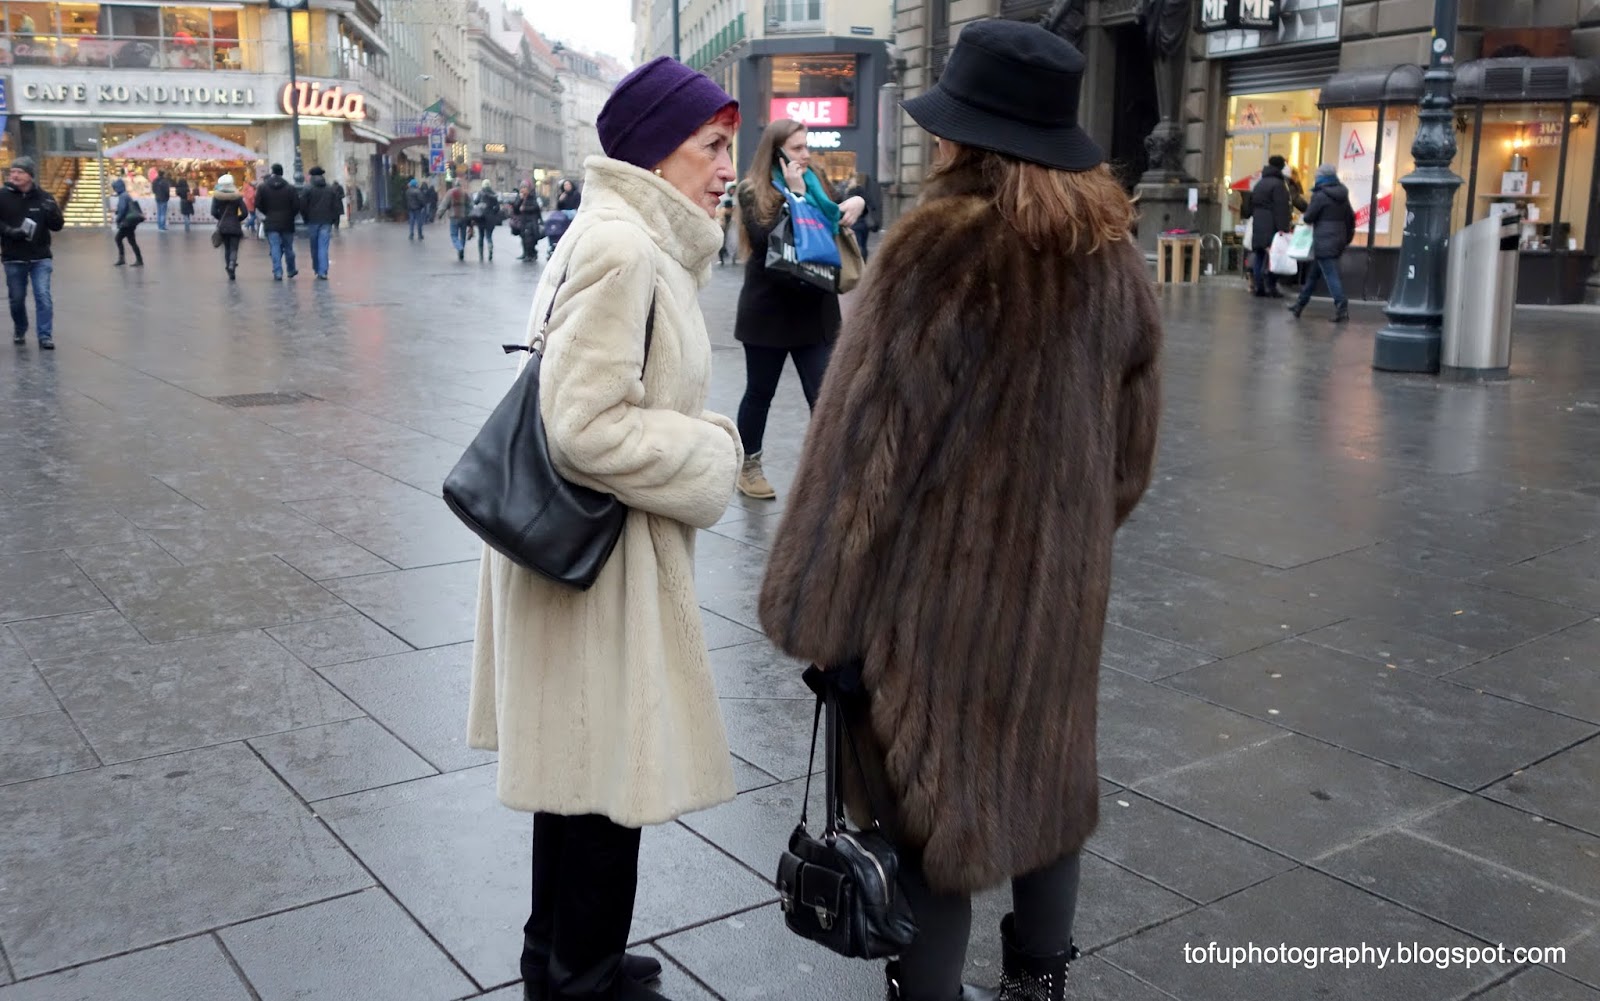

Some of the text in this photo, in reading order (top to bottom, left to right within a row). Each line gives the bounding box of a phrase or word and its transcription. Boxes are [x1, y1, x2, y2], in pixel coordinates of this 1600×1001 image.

[97, 84, 256, 104] KONDITOREI
[786, 101, 832, 124] SALE
[806, 131, 841, 148] ANIC
